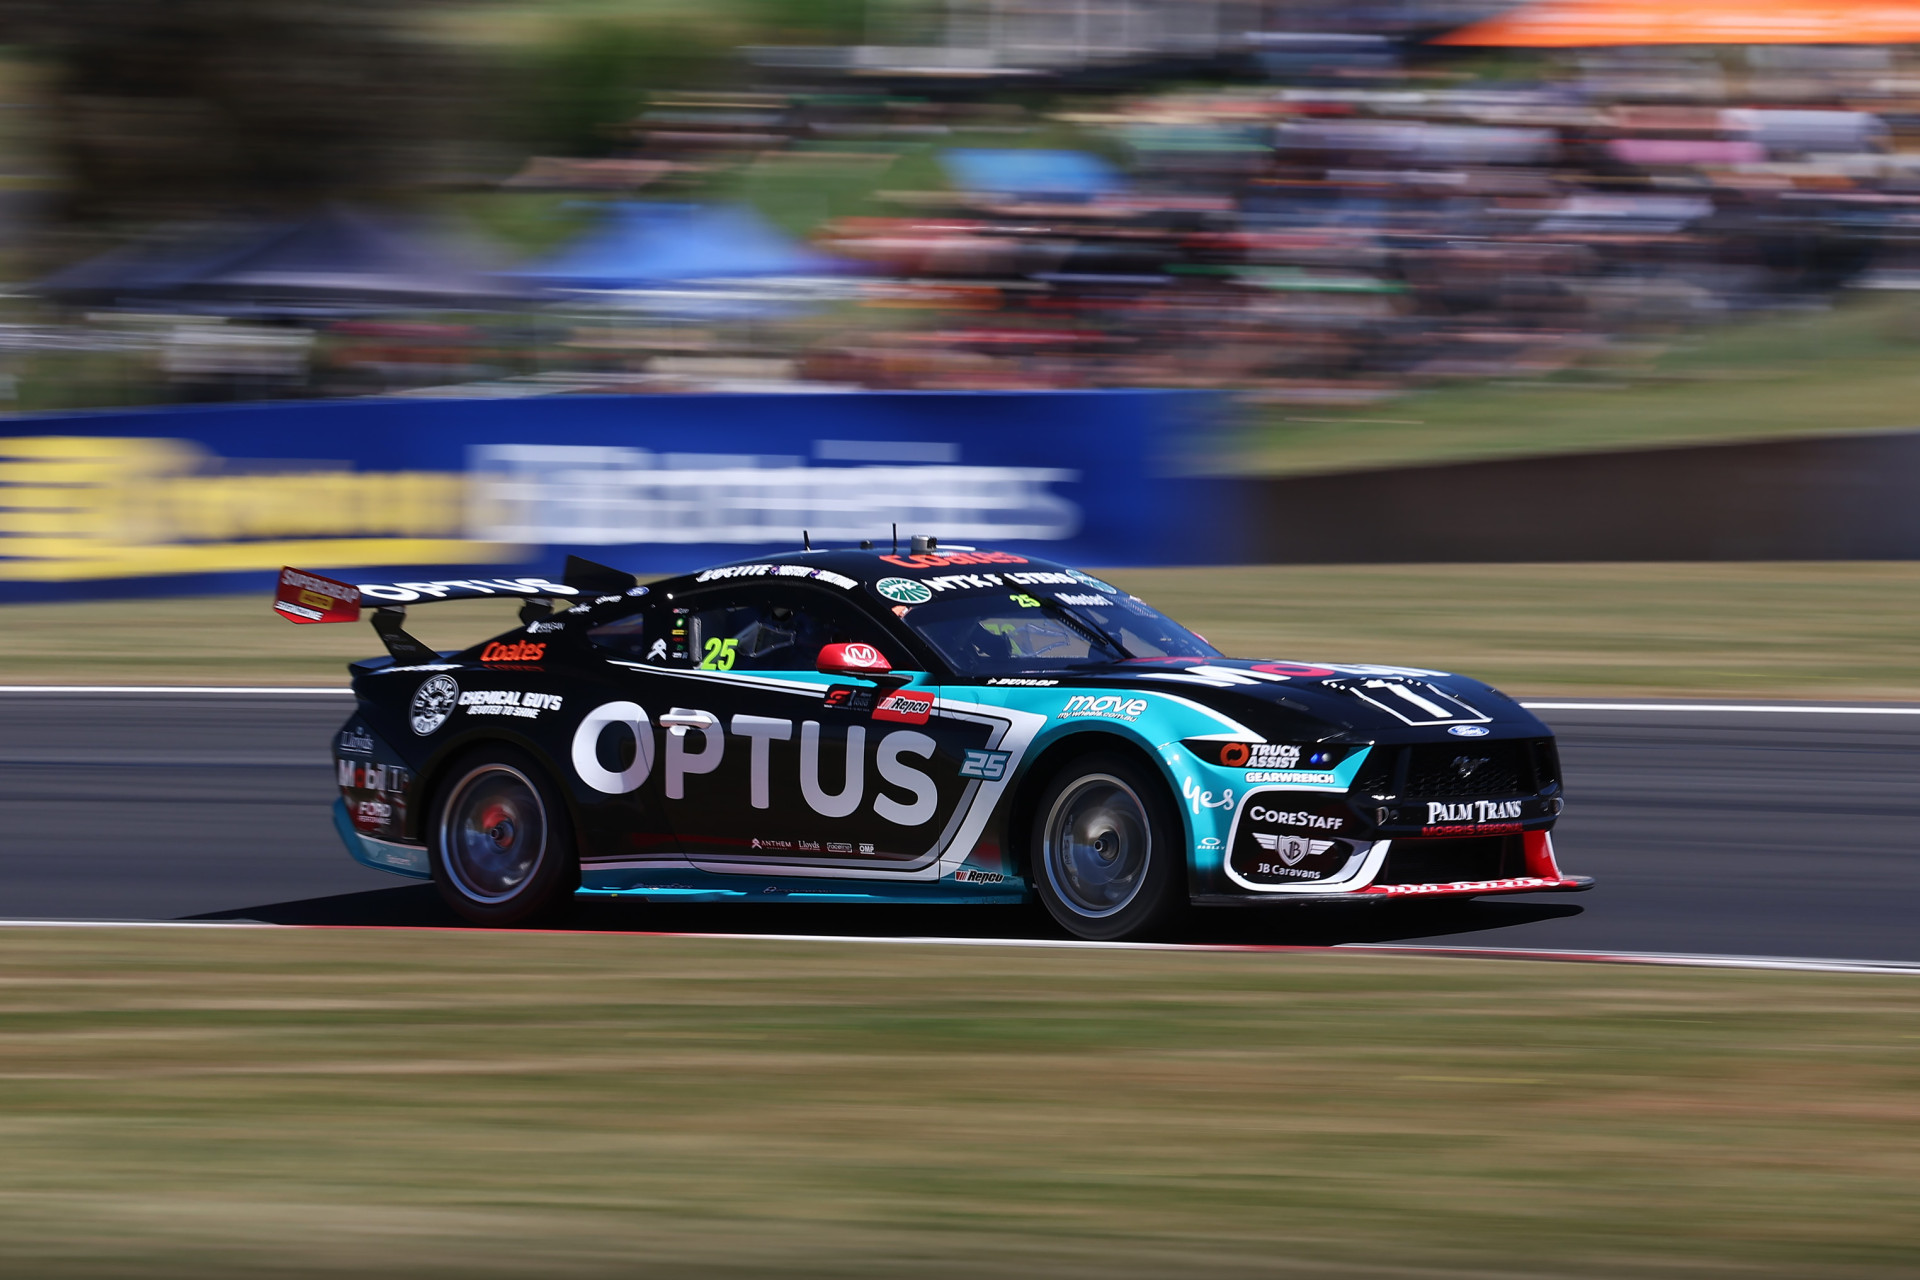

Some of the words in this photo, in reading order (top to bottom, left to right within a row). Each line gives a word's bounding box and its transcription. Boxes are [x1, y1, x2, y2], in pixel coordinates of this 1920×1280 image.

[878, 552, 1029, 568] Coates
[695, 564, 773, 582] LOCTITE
[355, 578, 580, 601] OPTUS
[883, 582, 917, 594] MTK
[920, 574, 983, 592] MTK
[983, 572, 1077, 586] FLTERS
[1009, 594, 1041, 608] 25
[480, 640, 546, 662] Coates
[701, 637, 738, 671] 25
[850, 648, 872, 659] M
[996, 678, 1059, 687] DUNLOP
[458, 690, 521, 706] CHEMICAL
[522, 692, 563, 711] GUYS
[891, 696, 931, 714] Repco
[1062, 695, 1148, 716] move
[466, 705, 503, 716] DEVOTED
[510, 707, 541, 719] SHINE
[1251, 744, 1302, 757] TRUCK
[571, 701, 938, 826] OPTUS
[961, 753, 1008, 777] 25
[1245, 756, 1299, 769] ASSIST
[1245, 772, 1335, 784] GEARWRENCH
[358, 801, 391, 817] FORD
[1426, 801, 1473, 825] PALM
[1475, 800, 1522, 823] TRANS
[1421, 824, 1475, 837] MORRIS
[761, 840, 792, 848] ANTHEM
[798, 840, 820, 851] Lloyds
[859, 844, 875, 853] OMP
[967, 869, 1004, 885] Repco
[1257, 863, 1270, 874] JB
[1271, 864, 1321, 880] Caravans
